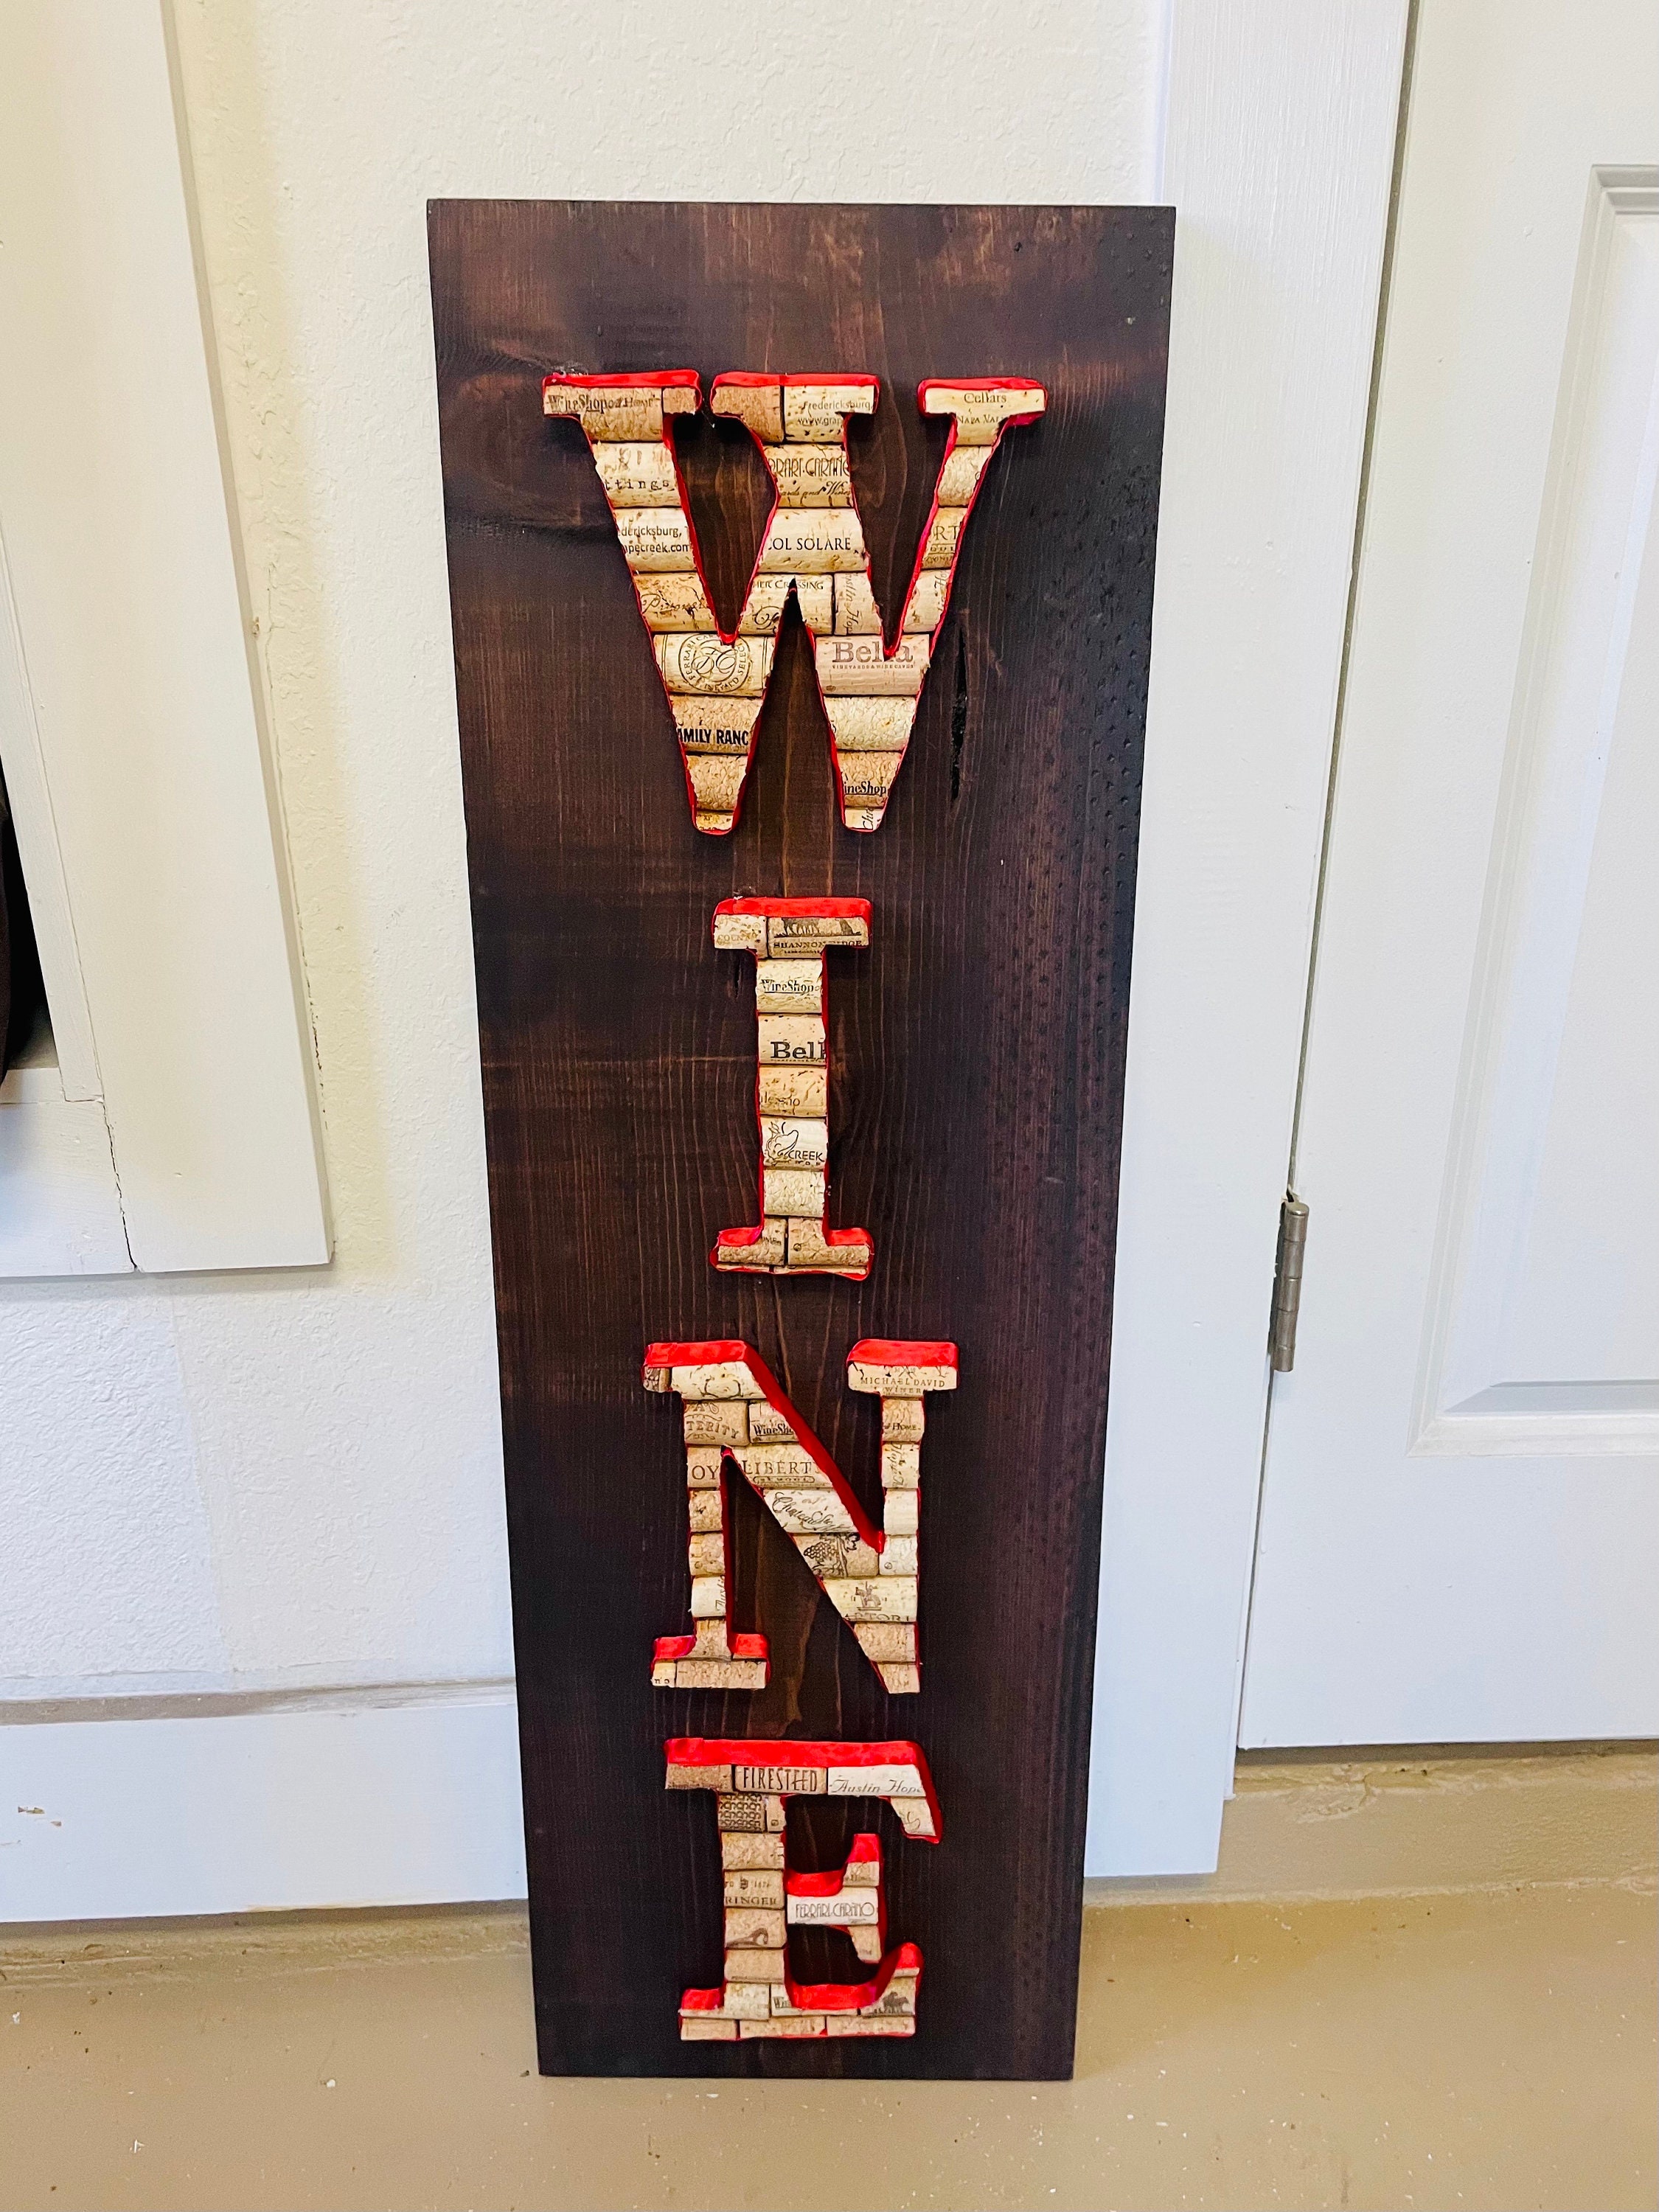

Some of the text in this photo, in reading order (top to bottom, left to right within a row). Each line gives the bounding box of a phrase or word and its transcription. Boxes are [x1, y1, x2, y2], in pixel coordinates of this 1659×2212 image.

[964, 392, 1007, 404] Cellars
[618, 526, 683, 538] dericksburg,
[796, 538, 852, 551] SOLARE
[832, 641, 914, 663] Bela
[787, 1150, 825, 1162] CREEK
[860, 1377, 946, 1388] MICHAEL DAVID
[692, 1465, 720, 1481] OY
[742, 1460, 820, 1475] LIBERT
[743, 1767, 818, 1792] FIRESTEED
[832, 1779, 880, 1793] Austin
